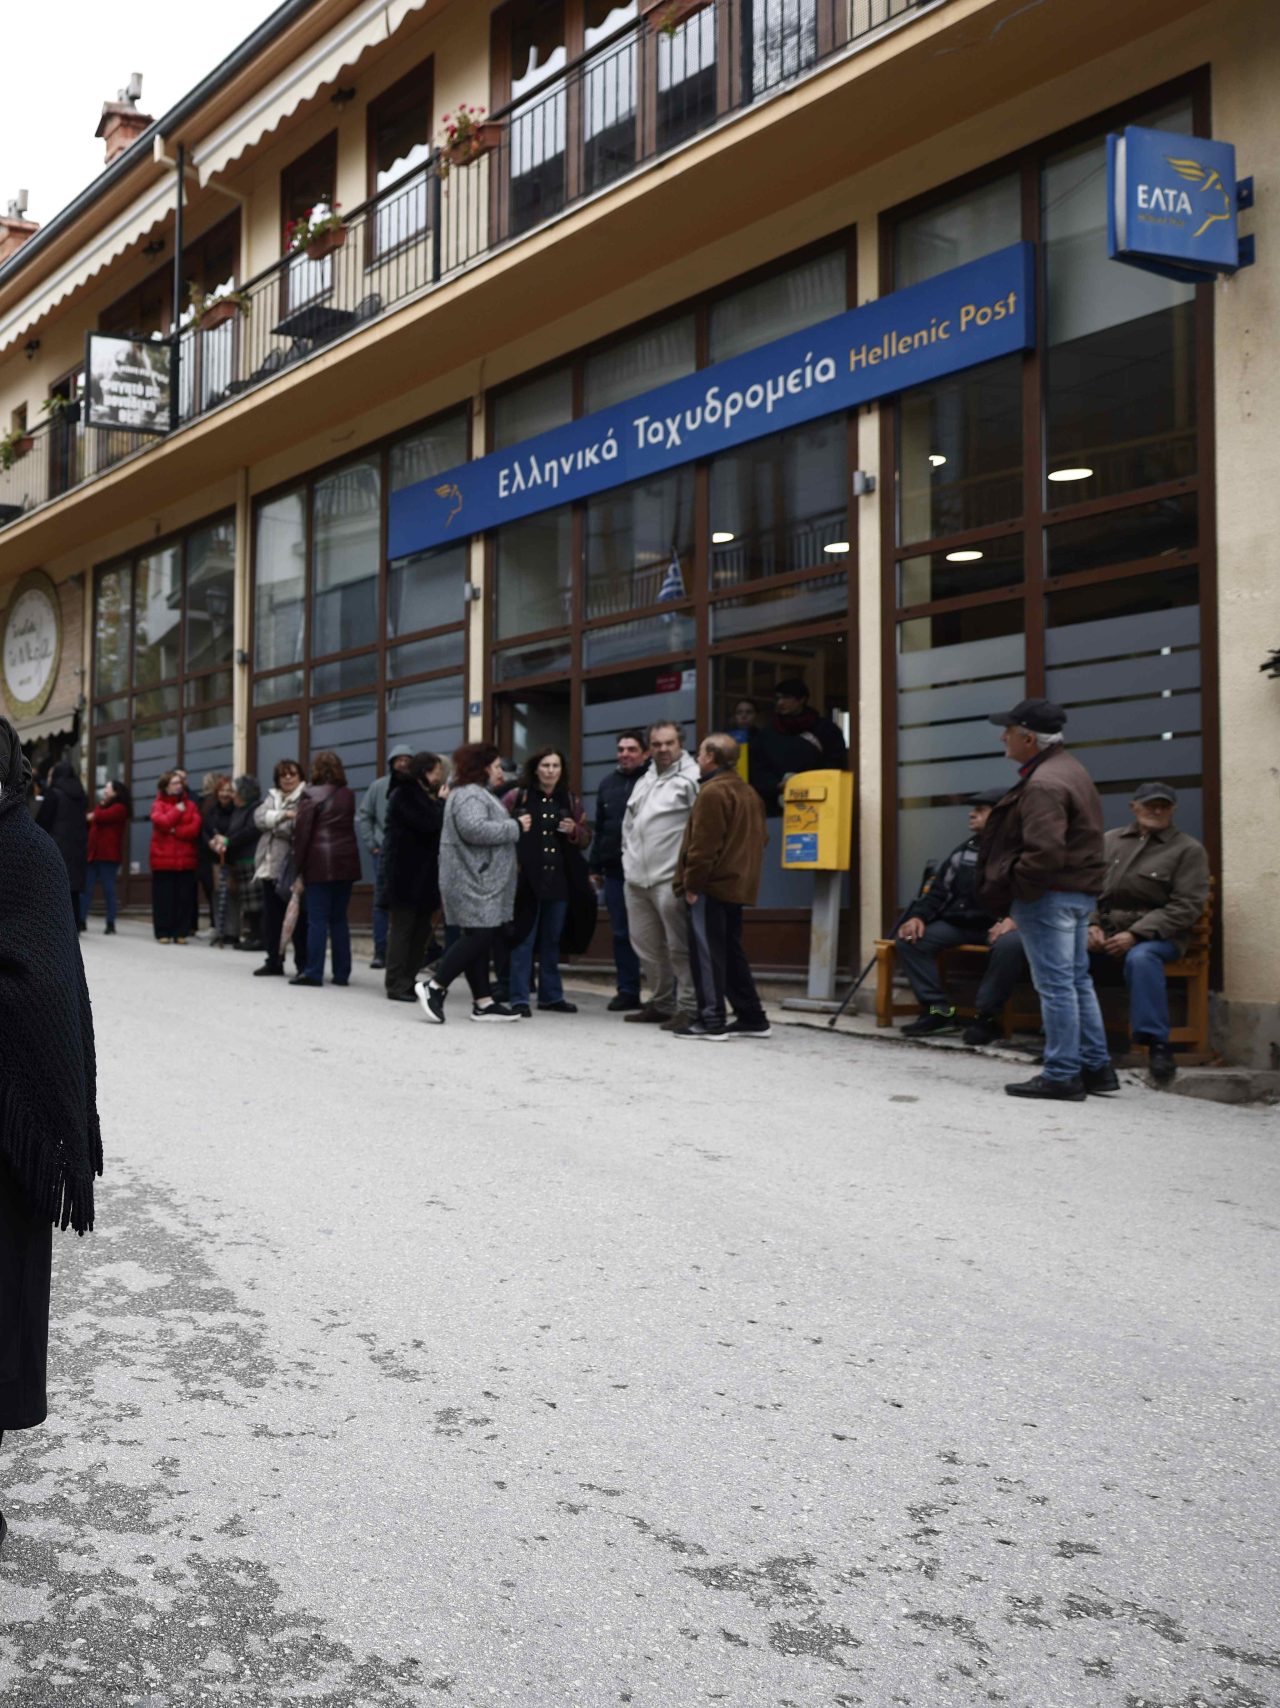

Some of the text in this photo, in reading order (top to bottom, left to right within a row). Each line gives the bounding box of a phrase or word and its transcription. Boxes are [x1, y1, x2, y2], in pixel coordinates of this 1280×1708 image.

[1137, 184, 1192, 215] ΕΛΤΑ
[498, 292, 1017, 498] Ελληνικά Ταχυδρομεία Hellenic Post
